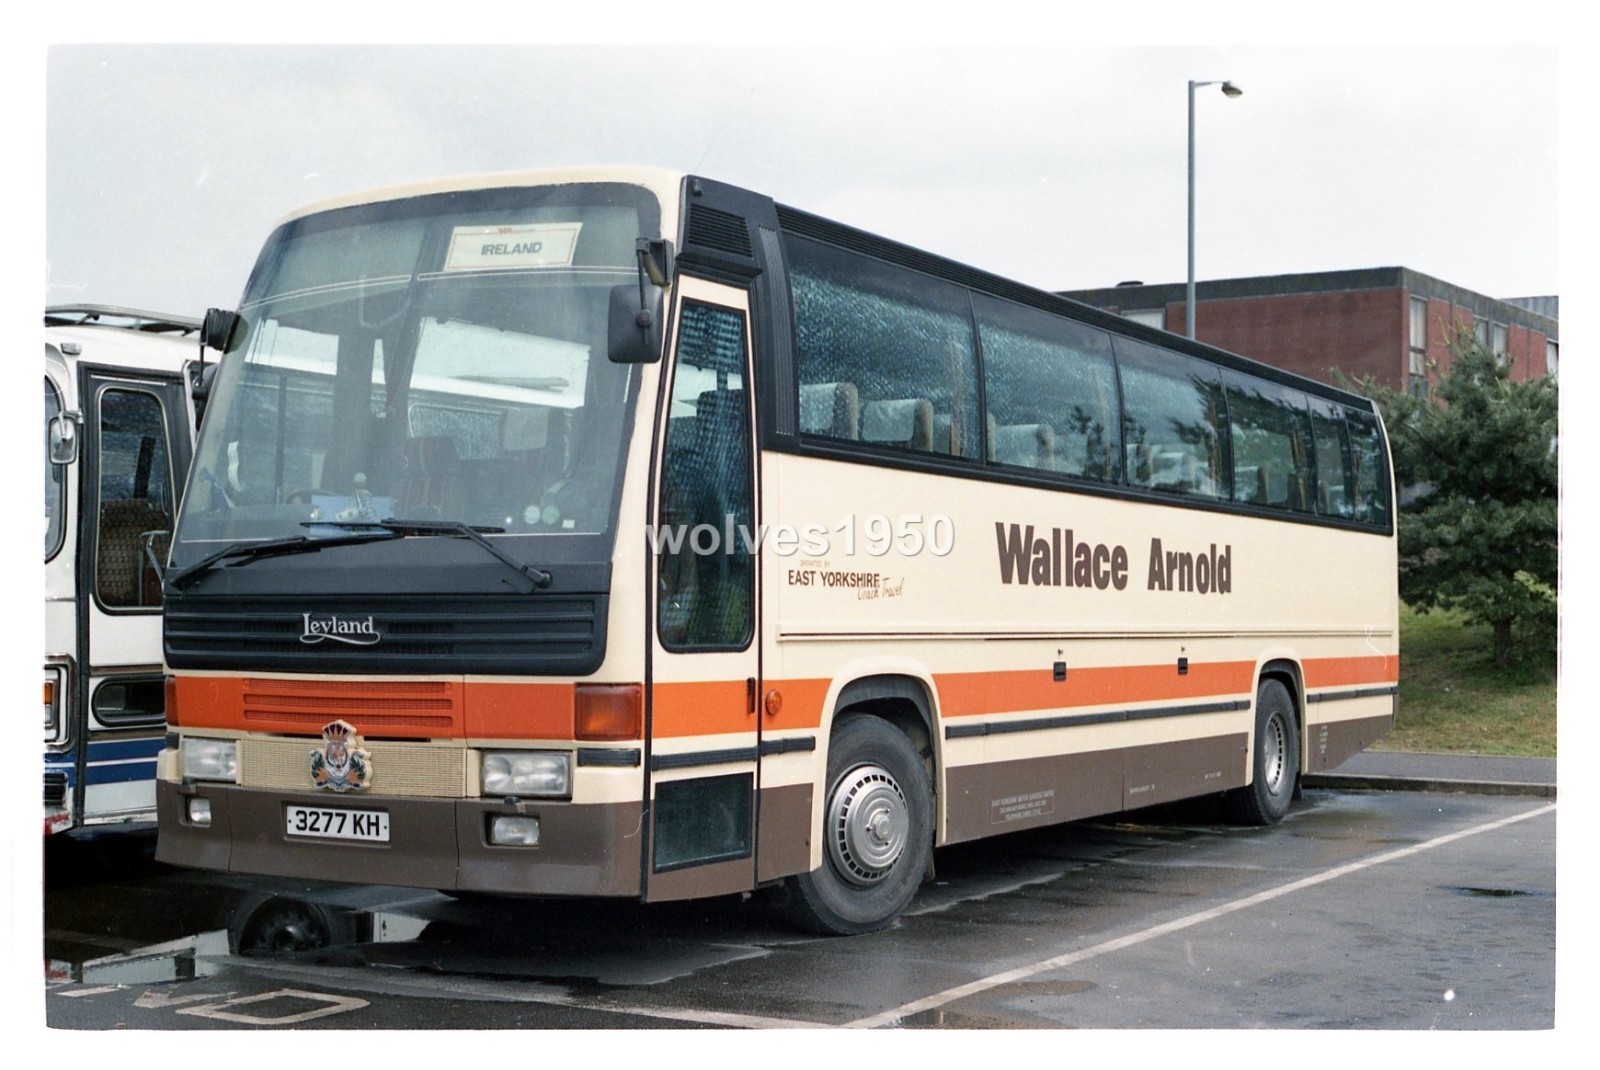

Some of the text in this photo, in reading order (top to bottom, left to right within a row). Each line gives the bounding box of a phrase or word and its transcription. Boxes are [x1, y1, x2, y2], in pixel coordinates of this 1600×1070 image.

[481, 241, 543, 256] IRELAND
[995, 521, 1232, 595] Wallace Arnold
[788, 569, 880, 588] EAST YORKSHIRE
[300, 613, 380, 645] Leyland
[295, 809, 380, 837] 3277 KH
